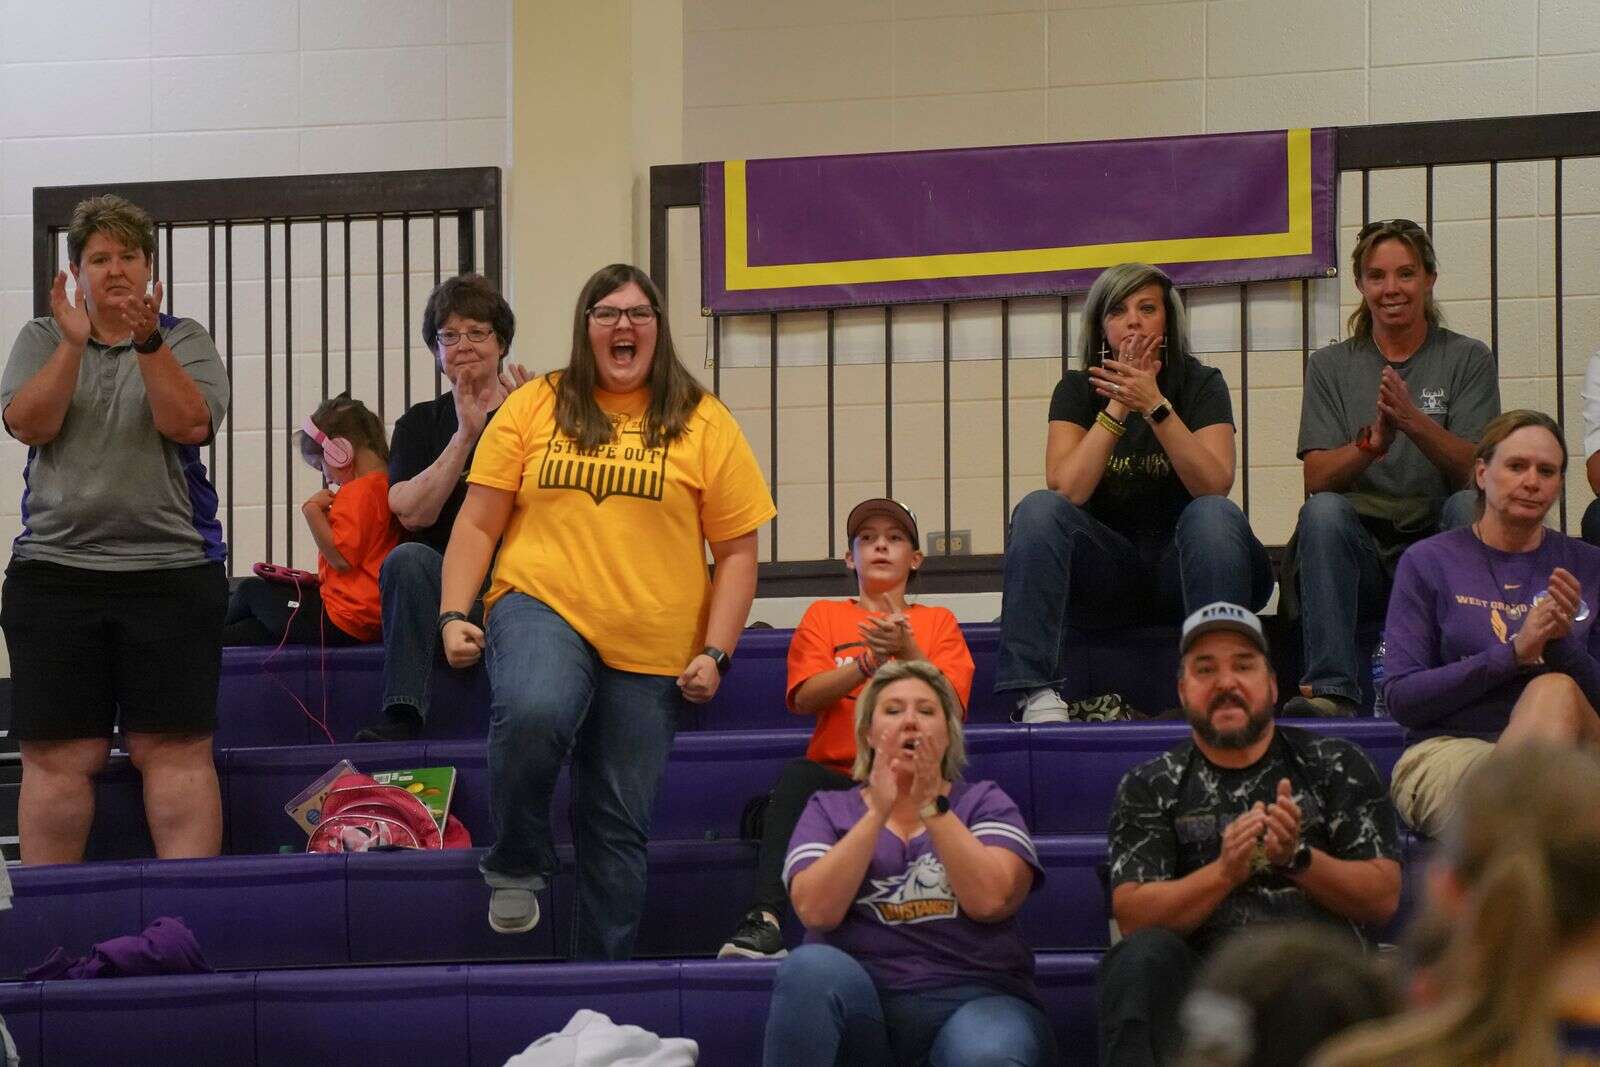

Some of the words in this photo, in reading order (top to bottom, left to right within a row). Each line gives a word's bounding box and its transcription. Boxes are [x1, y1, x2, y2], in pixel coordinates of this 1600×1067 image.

[624, 447, 660, 464] OUT
[1456, 594, 1488, 608] WEST
[1202, 606, 1245, 618] STATE
